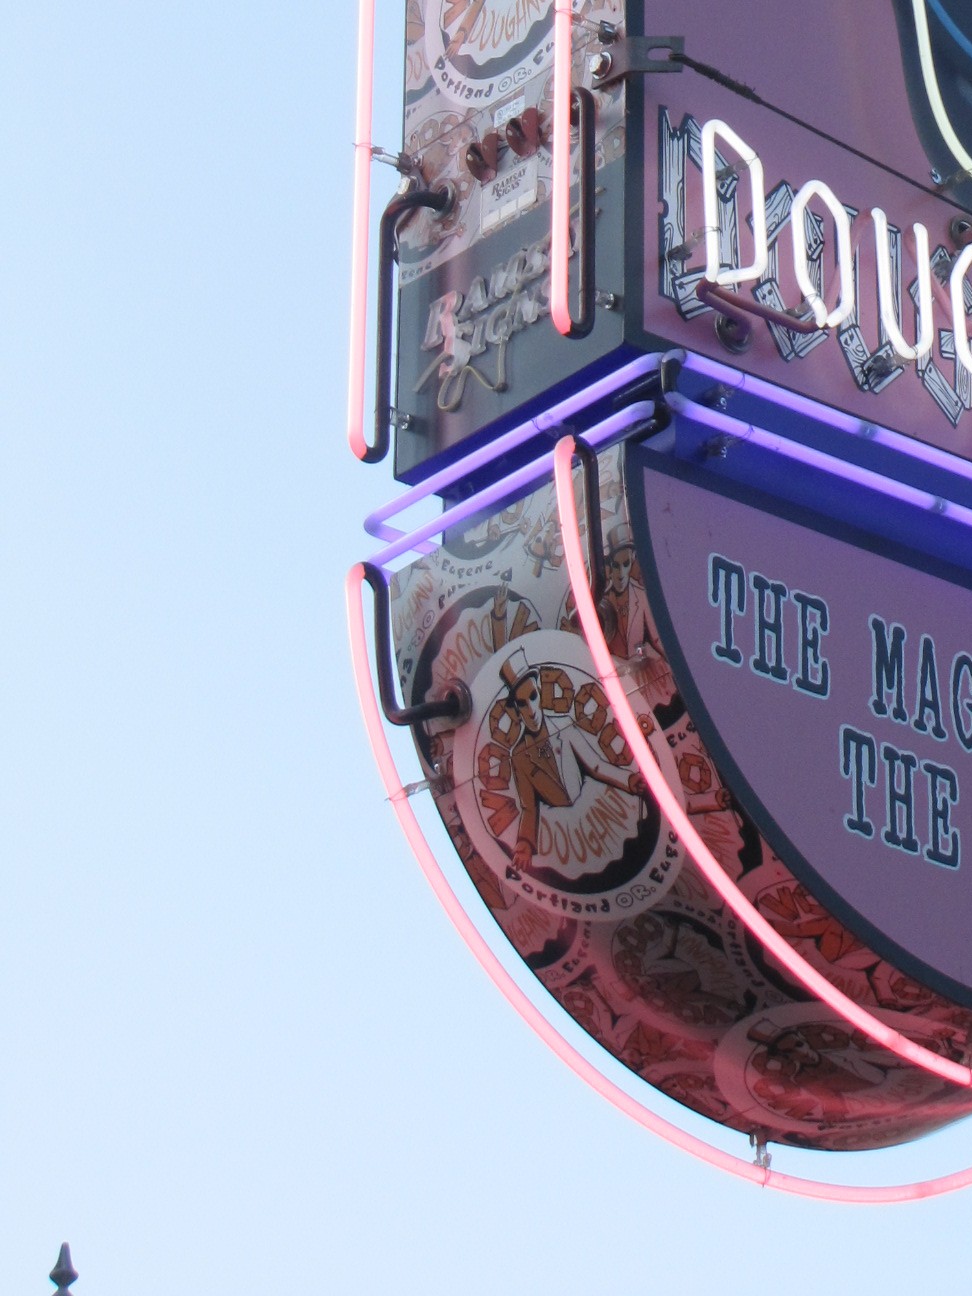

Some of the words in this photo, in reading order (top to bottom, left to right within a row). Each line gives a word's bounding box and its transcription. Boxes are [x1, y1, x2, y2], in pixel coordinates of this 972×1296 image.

[492, 166, 528, 196] RAMSAY
[495, 179, 522, 202] SIGNS
[707, 552, 831, 700] THE
[838, 723, 961, 870] THE
[505, 866, 612, 914] Portland
